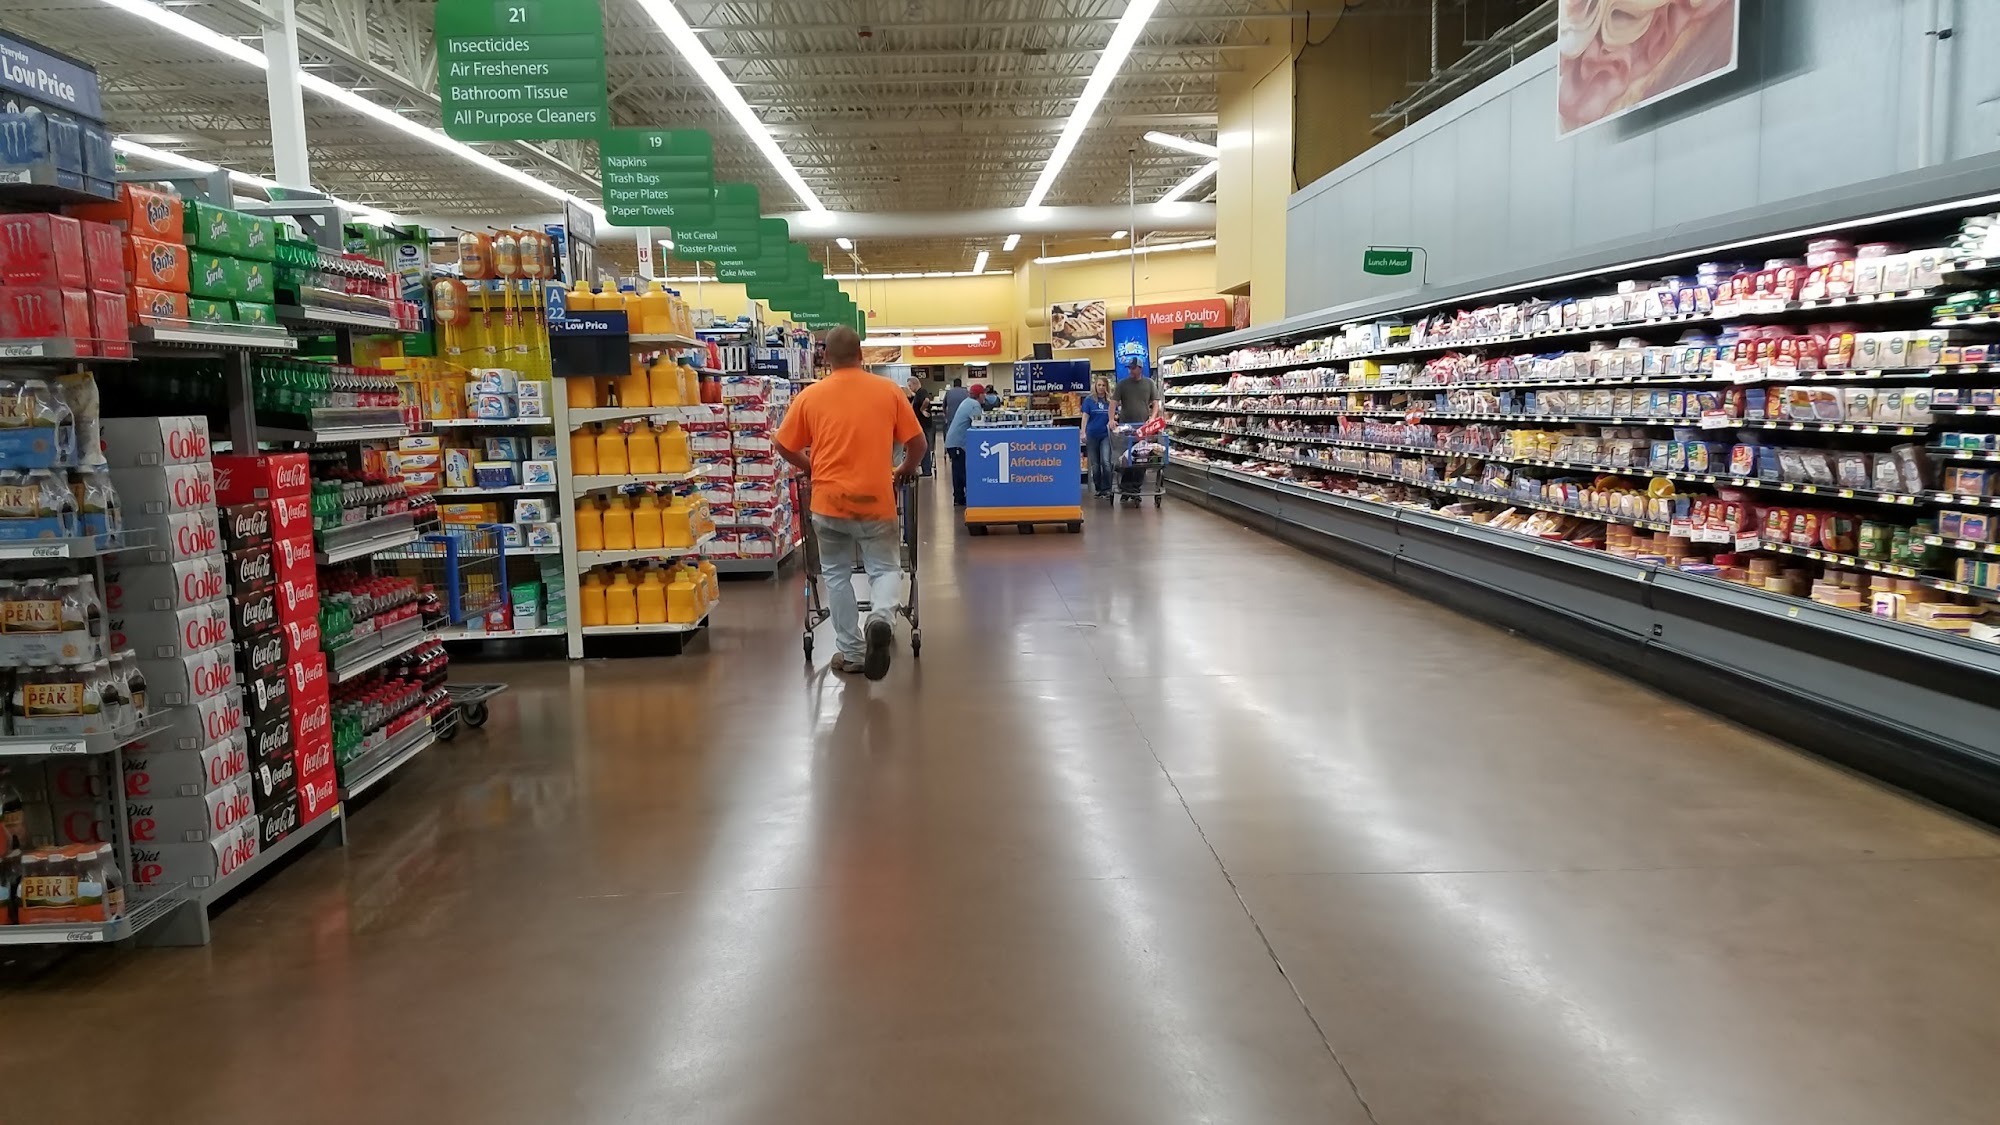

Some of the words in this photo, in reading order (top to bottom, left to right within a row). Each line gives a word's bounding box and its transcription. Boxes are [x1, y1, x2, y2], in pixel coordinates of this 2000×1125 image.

[509, 7, 526, 23] 21
[449, 37, 530, 53] Insecticides
[0, 44, 29, 64] Everyday
[450, 62, 470, 77] Air
[473, 61, 549, 76] Fresheners
[2, 55, 36, 89] Low
[36, 68, 76, 102] Price
[451, 86, 521, 100] Bathroom
[524, 85, 568, 99] Tissue
[454, 110, 472, 125] All
[476, 110, 533, 127] Purpose
[536, 109, 597, 123] Cleaners
[649, 136, 662, 147] 19
[607, 157, 648, 169] Napkins
[609, 173, 635, 183] Trash
[636, 173, 660, 185] Bags
[610, 189, 638, 201] Paper
[641, 188, 669, 199] Plates
[147, 201, 170, 225] Fanta
[612, 205, 639, 218] Paper
[641, 205, 675, 216] Towels
[210, 222, 229, 240] Sprite
[677, 231, 692, 240] Hot
[693, 231, 718, 240] Cereal
[248, 230, 264, 249] Sprite
[679, 245, 706, 253] Toaster
[708, 245, 737, 253] Pastries
[151, 250, 174, 275] Fanta
[1368, 257, 1388, 266] Lunch
[1389, 259, 1408, 267] Meat
[206, 267, 224, 287] Sprite
[721, 269, 737, 277] Cake
[738, 269, 757, 277] Mixes
[246, 272, 263, 292] Sprite
[550, 289, 561, 303] A
[548, 307, 566, 320] 22
[1150, 312, 1174, 325] Meat
[1175, 310, 1183, 323] &
[1184, 307, 1220, 323] Poultry
[565, 321, 584, 330] Low
[585, 321, 608, 330] Price
[1047, 382, 1064, 390] Price
[169, 430, 206, 459] Coke
[1010, 441, 1037, 452] Stock
[1038, 443, 1052, 453] up
[1053, 443, 1067, 451] on
[257, 458, 266, 466] 24
[1010, 458, 1062, 468] Affordable
[1010, 473, 1054, 483] Favorites
[174, 478, 212, 507] Coke
[178, 523, 216, 556] Coke
[184, 571, 223, 601] Coke
[5, 609, 45, 621] PEAK
[109, 619, 124, 631] iet
[186, 616, 227, 650] Coke
[194, 663, 232, 696] Coke
[28, 692, 67, 705] PEAK
[208, 706, 240, 740] Coke
[122, 758, 147, 771] Diet
[211, 751, 245, 786] Coke
[128, 804, 153, 816] Diet
[215, 795, 250, 831] Coke
[133, 851, 160, 863] Diet
[222, 838, 256, 876] Coke
[26, 884, 62, 897] PEAK
